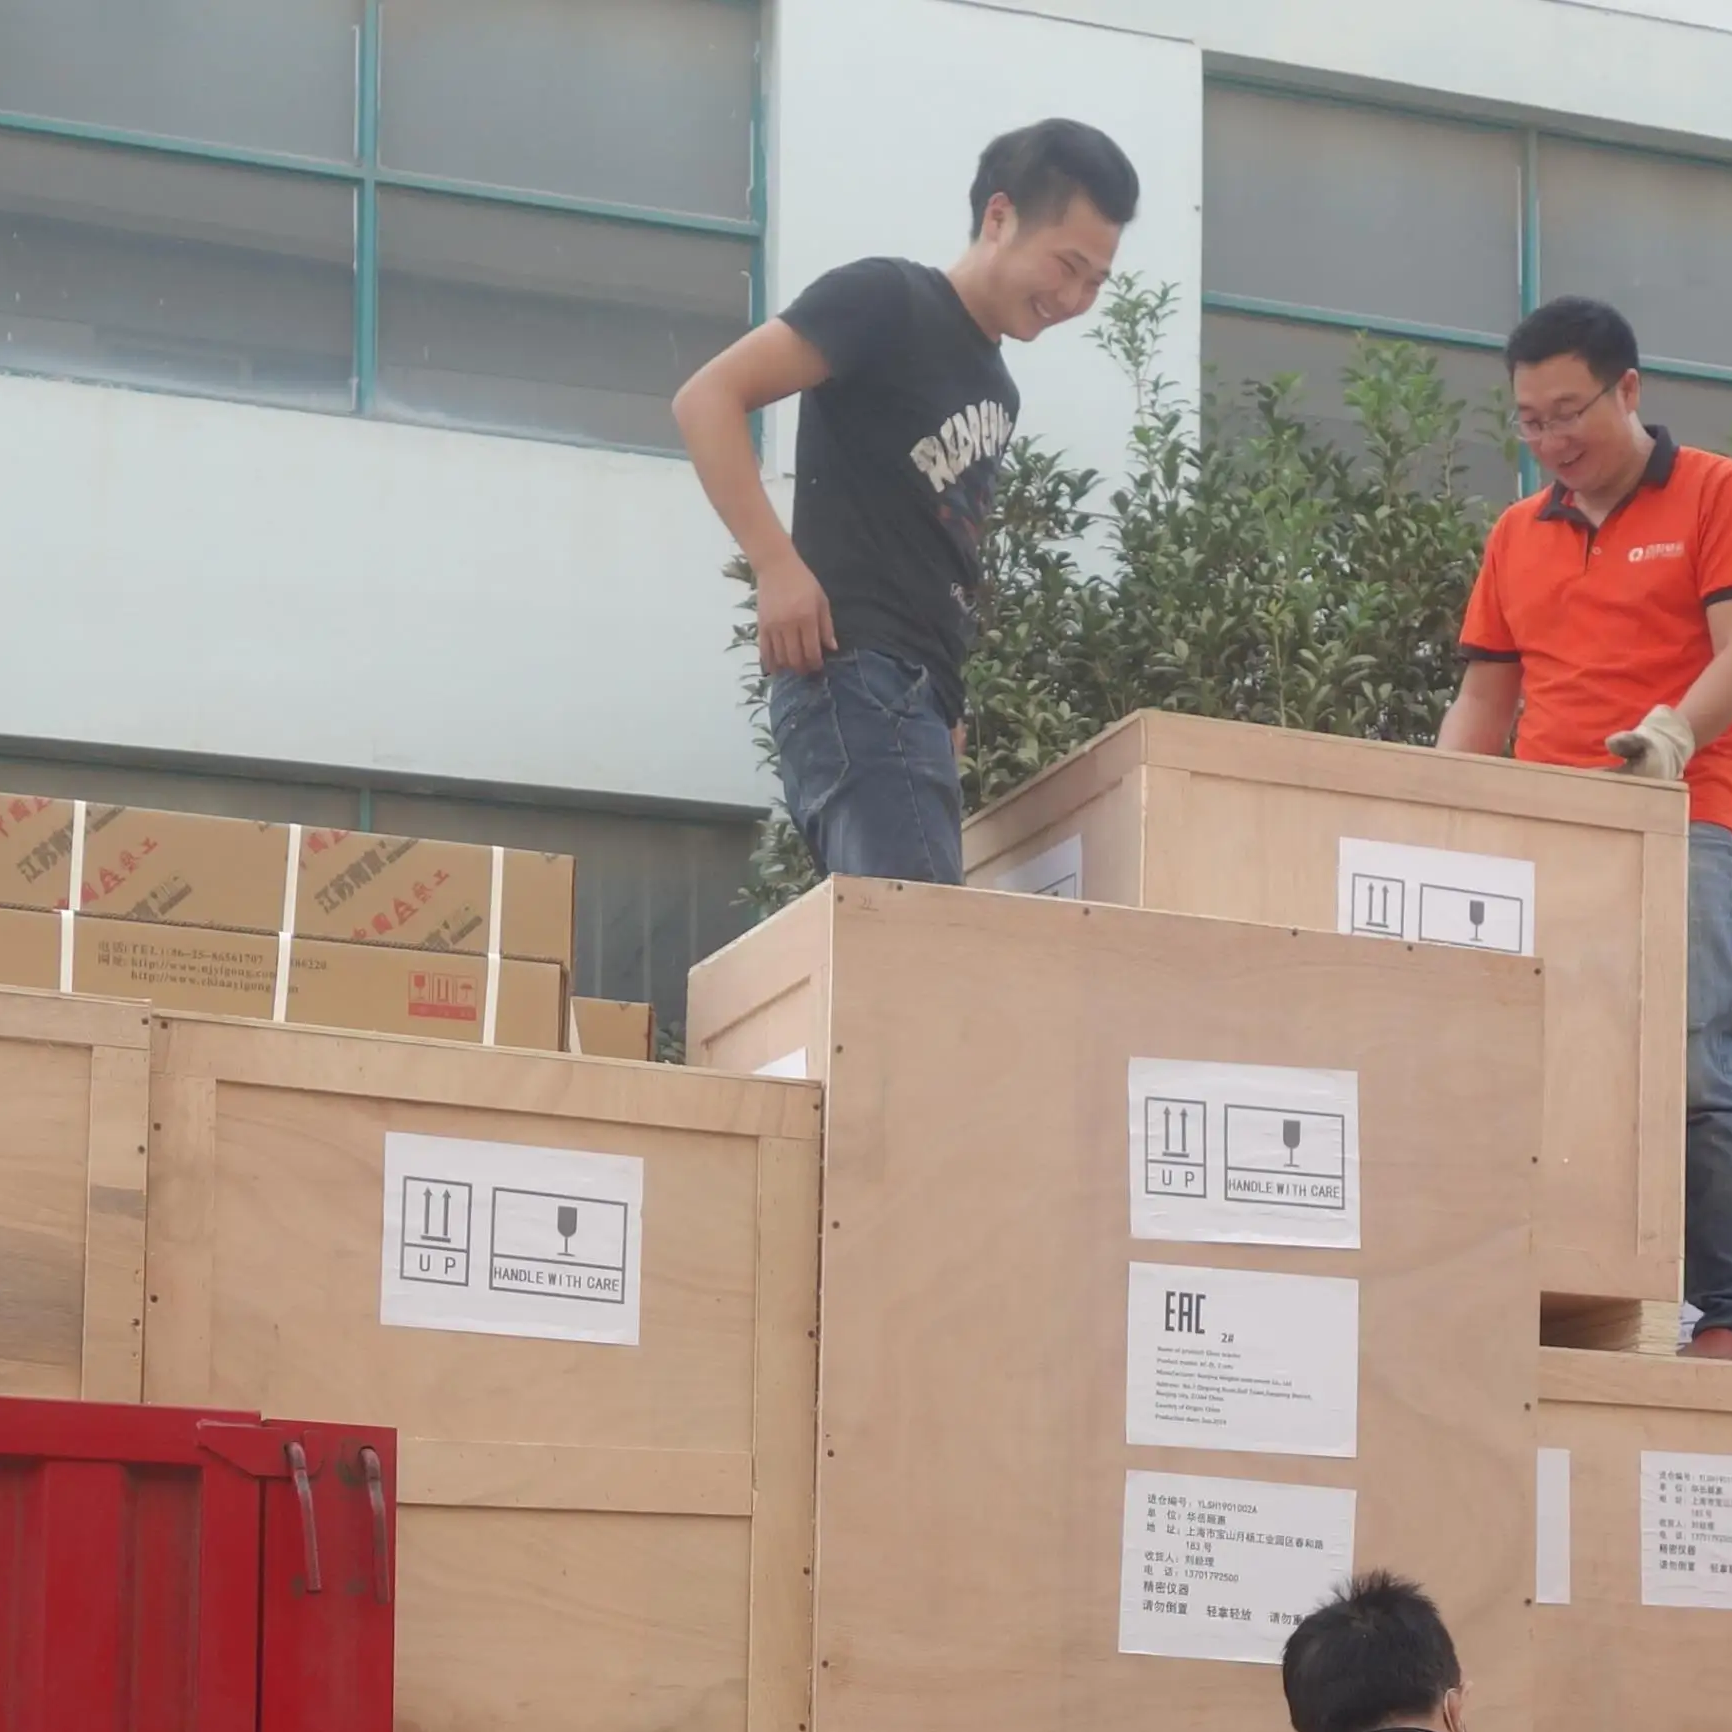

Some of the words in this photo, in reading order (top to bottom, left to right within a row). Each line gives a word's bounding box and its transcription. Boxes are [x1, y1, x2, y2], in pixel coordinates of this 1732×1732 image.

[1228, 1178, 1273, 1194] HANDLE
[1276, 1182, 1307, 1197] WITH
[1310, 1184, 1340, 1199] CARE
[493, 1266, 544, 1285] HANDLE
[548, 1273, 582, 1289] WITH
[586, 1276, 619, 1292] CARE
[1164, 1290, 1207, 1335] EAC
[1143, 1580, 1189, 1596] 精密仪器
[1142, 1599, 1188, 1616] 请勿倒置
[1206, 1605, 1252, 1621] 轻拿轻放
[1269, 1612, 1307, 1627] 请勿重
